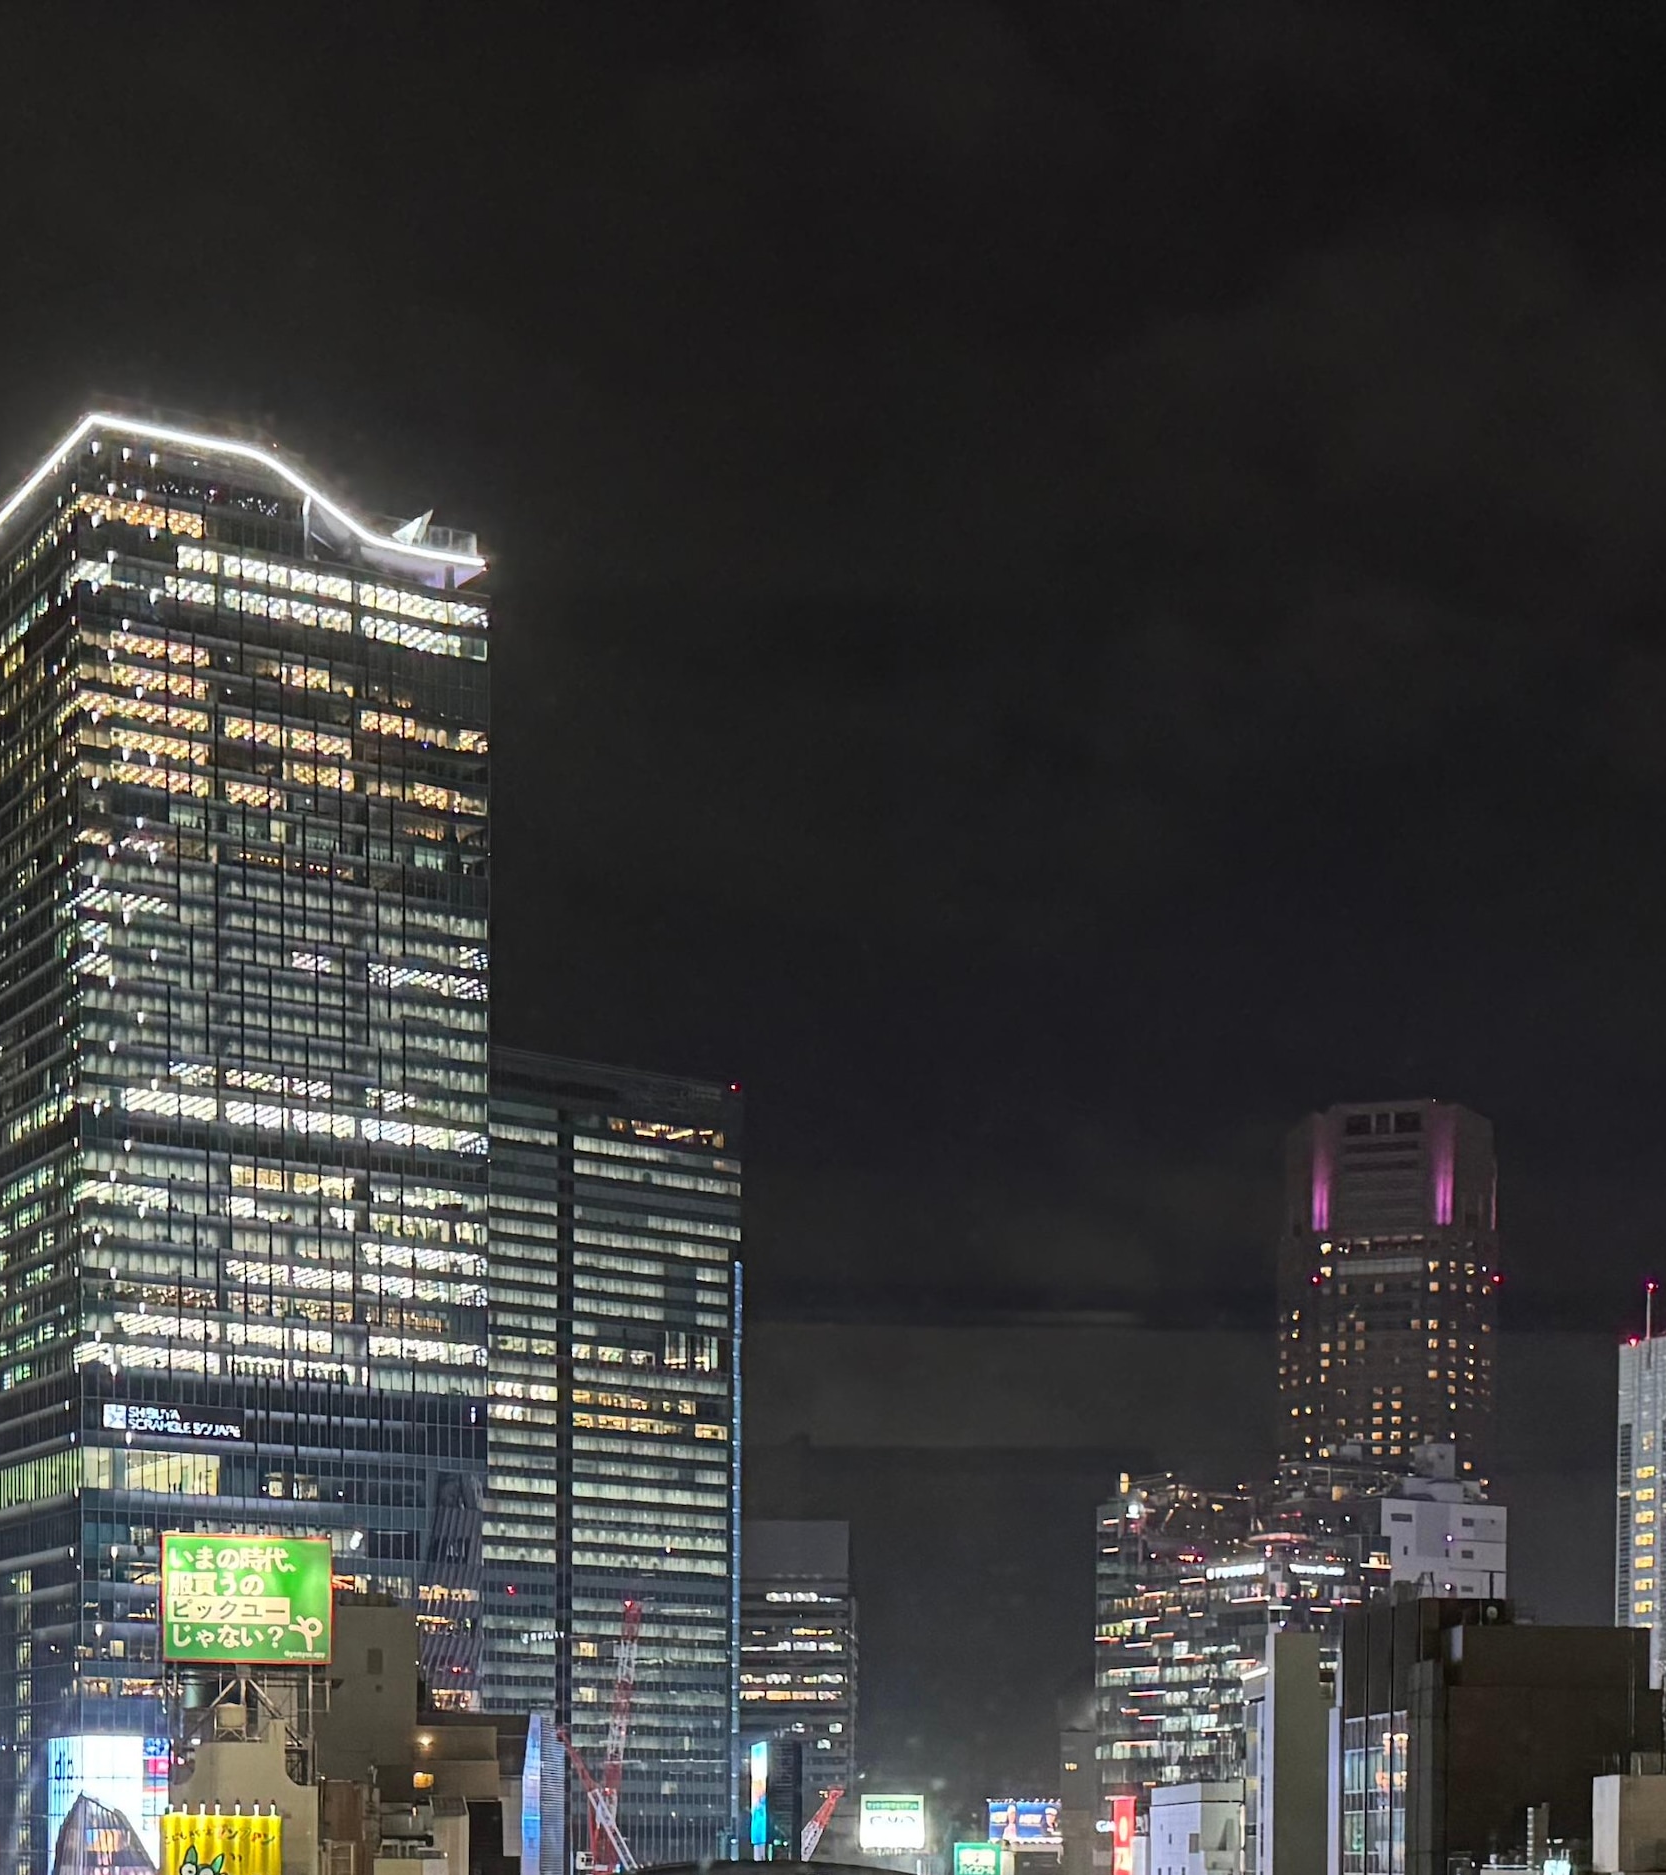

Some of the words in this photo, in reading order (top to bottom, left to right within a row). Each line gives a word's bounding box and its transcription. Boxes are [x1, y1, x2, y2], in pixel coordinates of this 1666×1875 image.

[127, 1406, 181, 1421] SHIBUYA
[127, 1419, 192, 1434] SCRAMBLE
[192, 1421, 241, 1438] SQUARE
[167, 1571, 265, 1597] 服買うの
[173, 1598, 286, 1620] ピックユー
